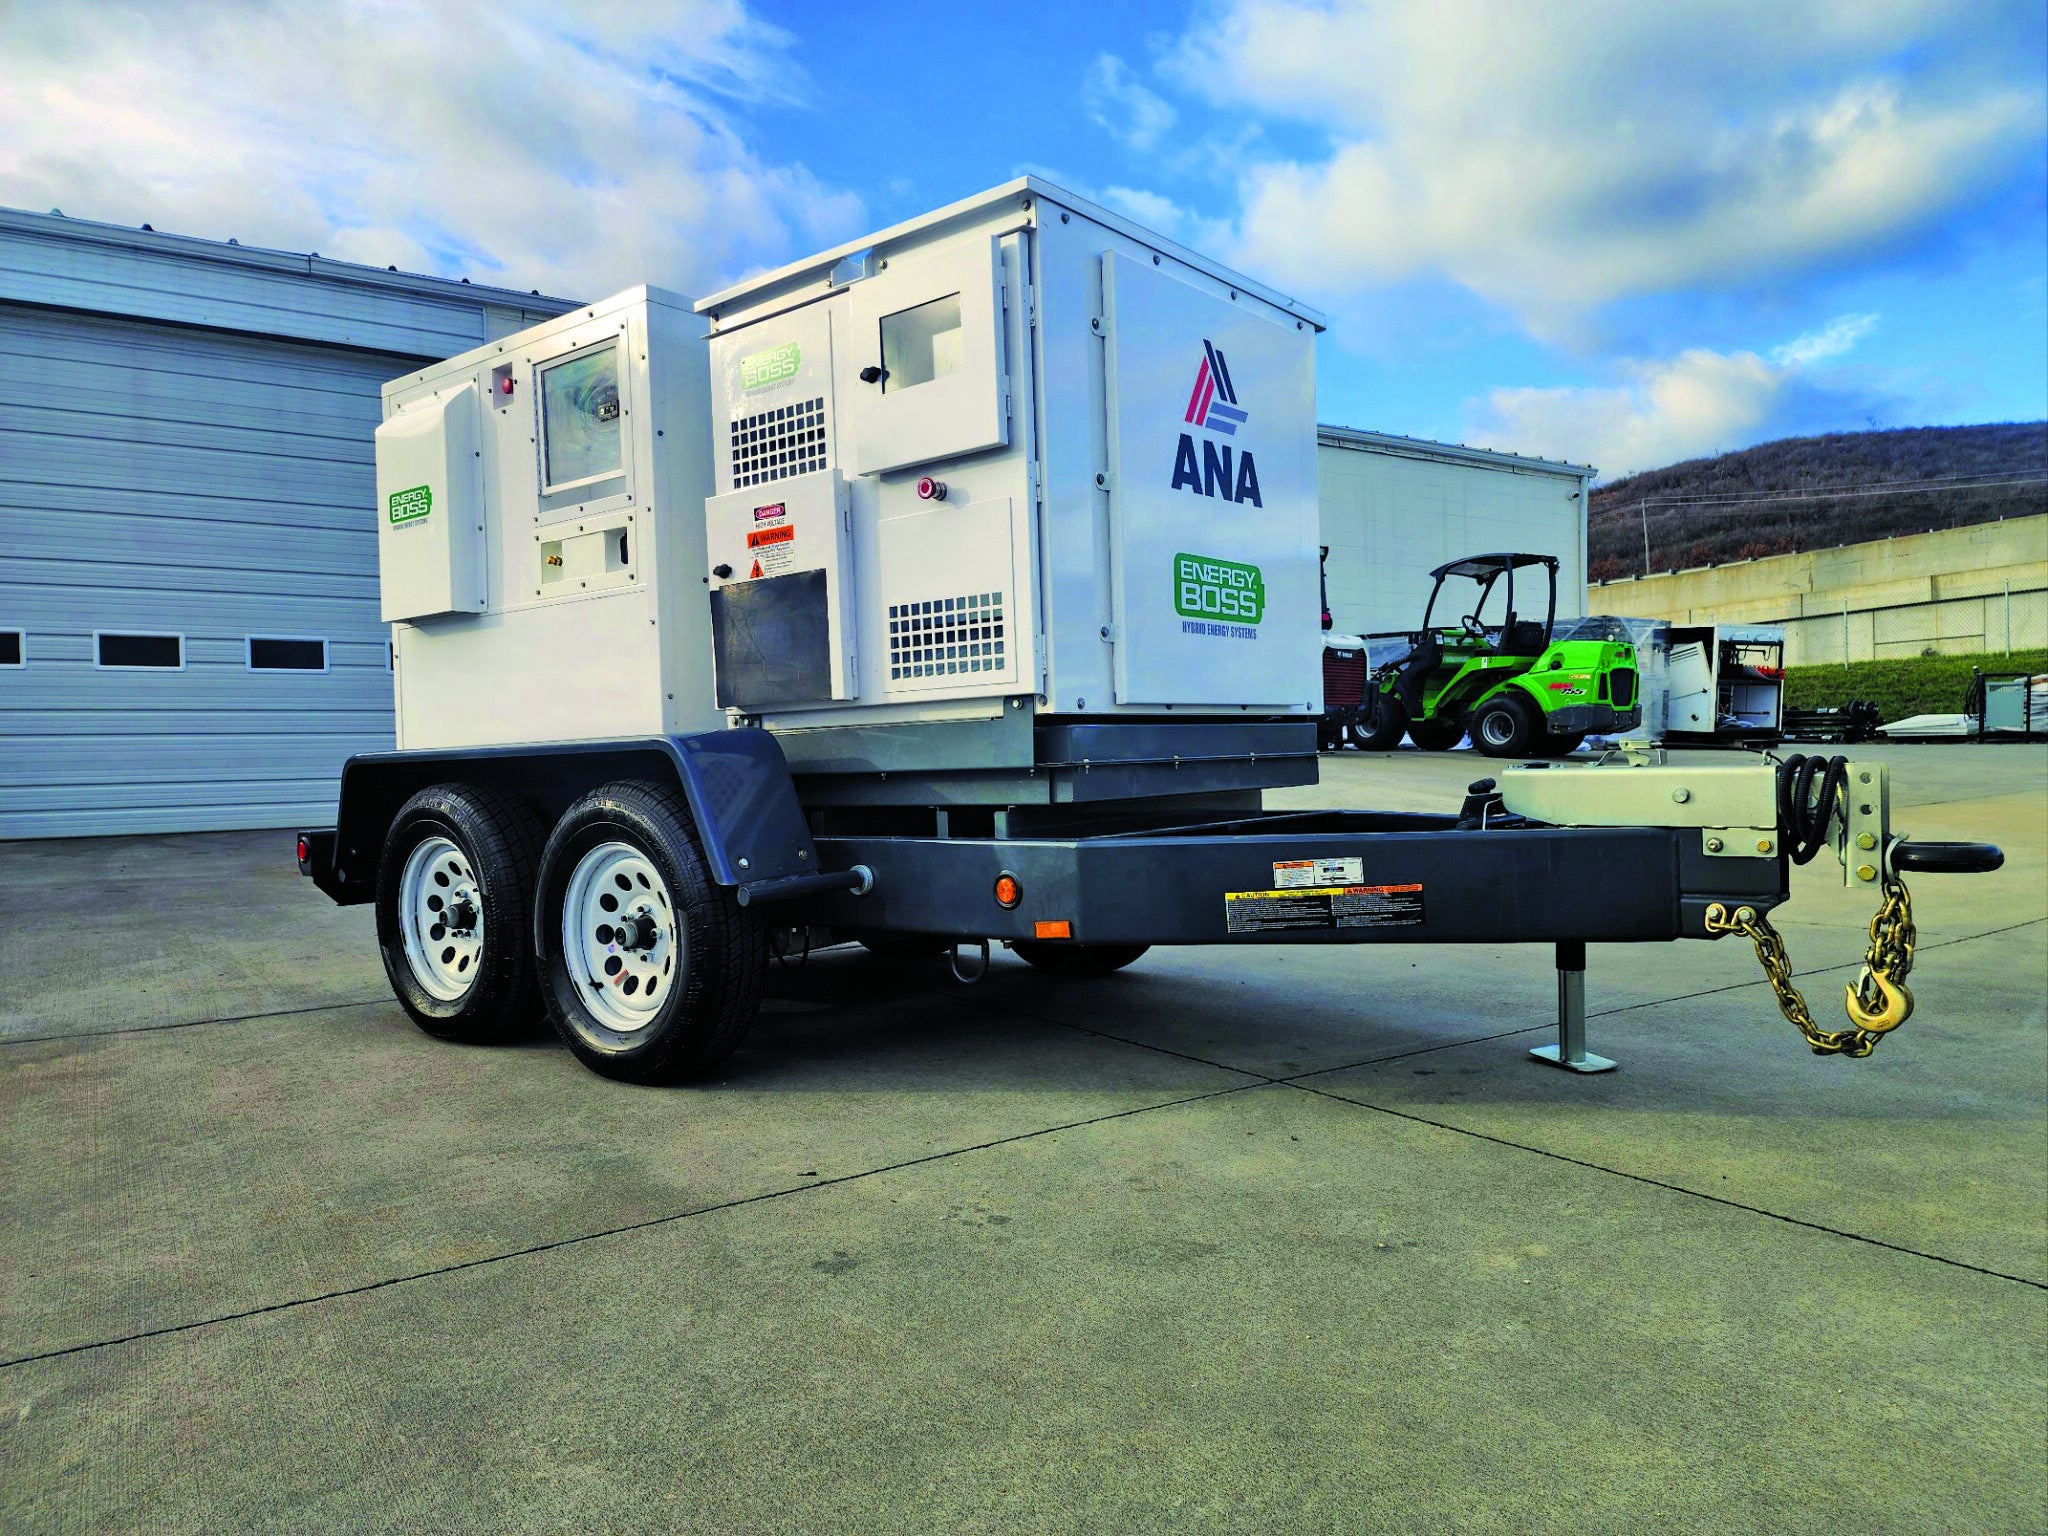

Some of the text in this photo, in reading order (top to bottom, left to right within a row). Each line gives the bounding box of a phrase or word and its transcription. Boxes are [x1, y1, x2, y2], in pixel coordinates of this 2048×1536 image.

[745, 360, 795, 386] BOSS
[1171, 433, 1263, 508] ANA
[391, 488, 427, 506] ENERGY
[392, 499, 428, 520] BOSS
[758, 506, 781, 517] DANGER
[760, 529, 791, 542] WARNING
[1180, 560, 1256, 589] ENERGY
[1181, 581, 1257, 618] BOSS
[1182, 621, 1257, 640] HYBRID ENERGY SYSTEMS
[1353, 886, 1384, 895] WARNING
